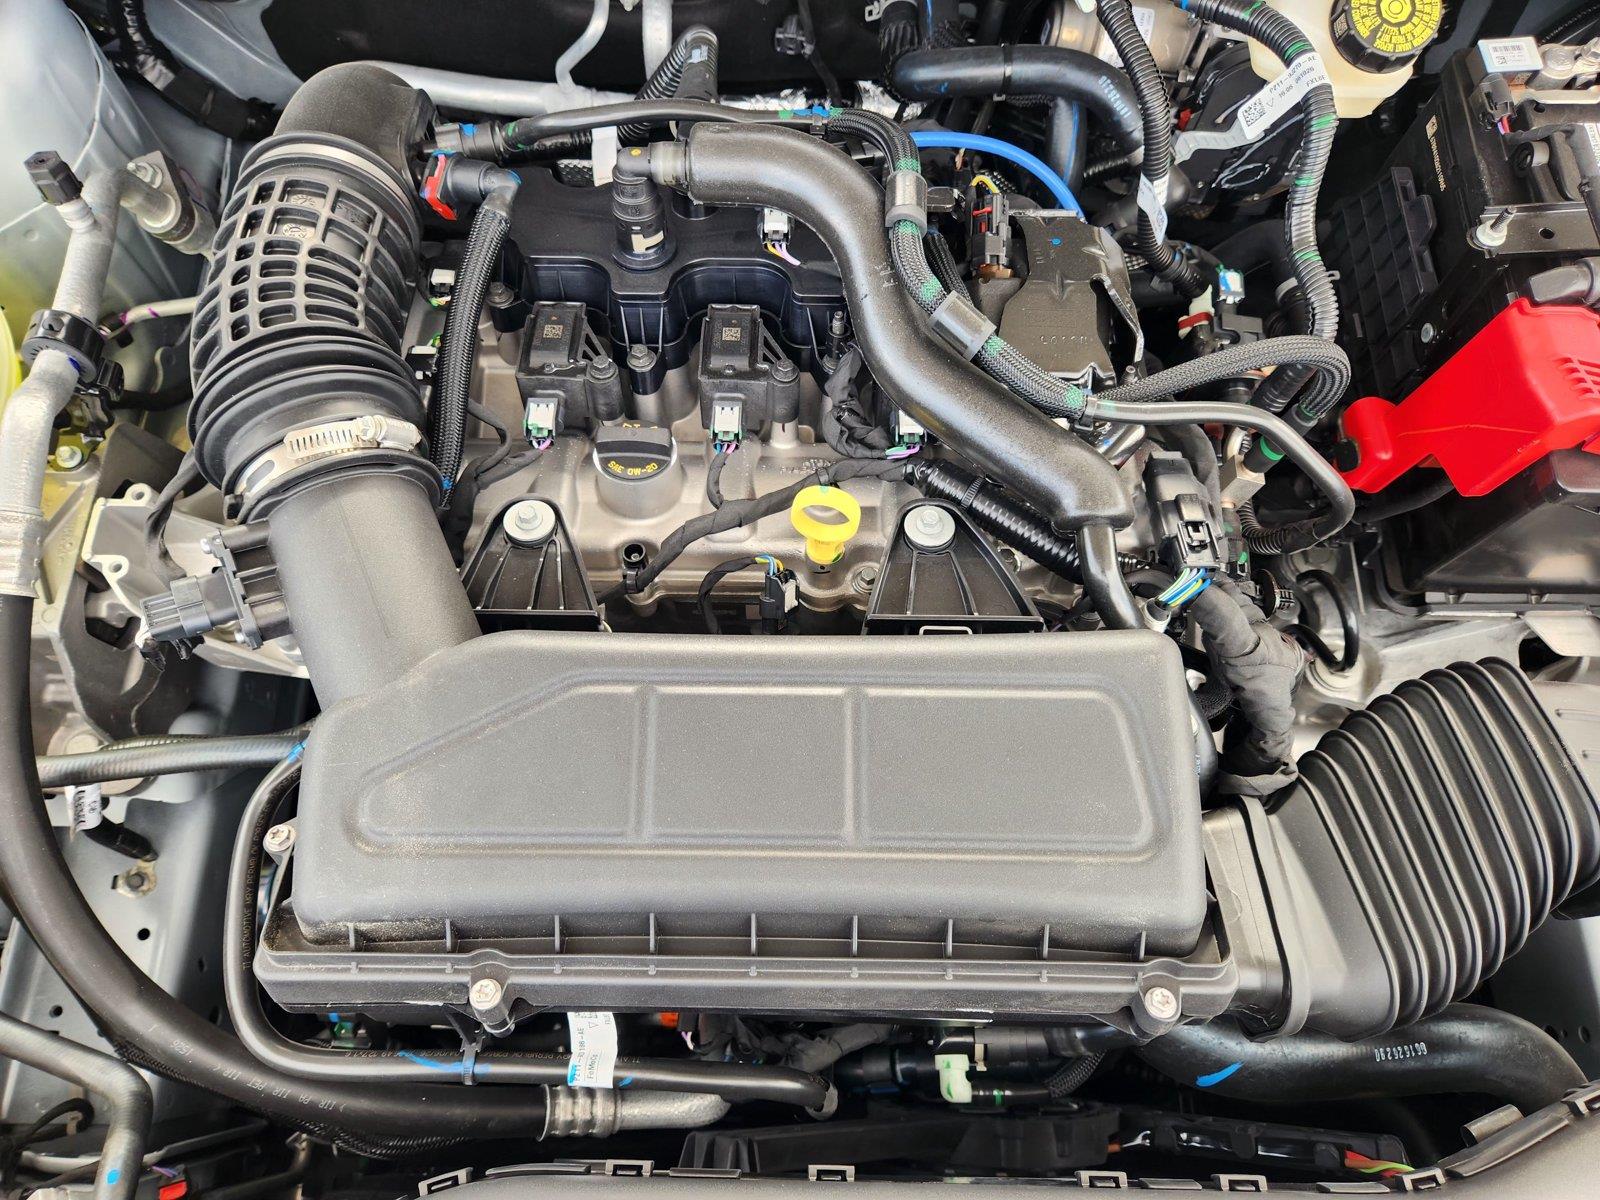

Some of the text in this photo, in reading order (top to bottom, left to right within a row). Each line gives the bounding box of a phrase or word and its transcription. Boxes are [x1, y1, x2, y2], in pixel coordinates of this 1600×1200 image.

[608, 460, 658, 476] SAE 0W-20
[246, 1075, 267, 1091] PET
[298, 1093, 312, 1104] PA
